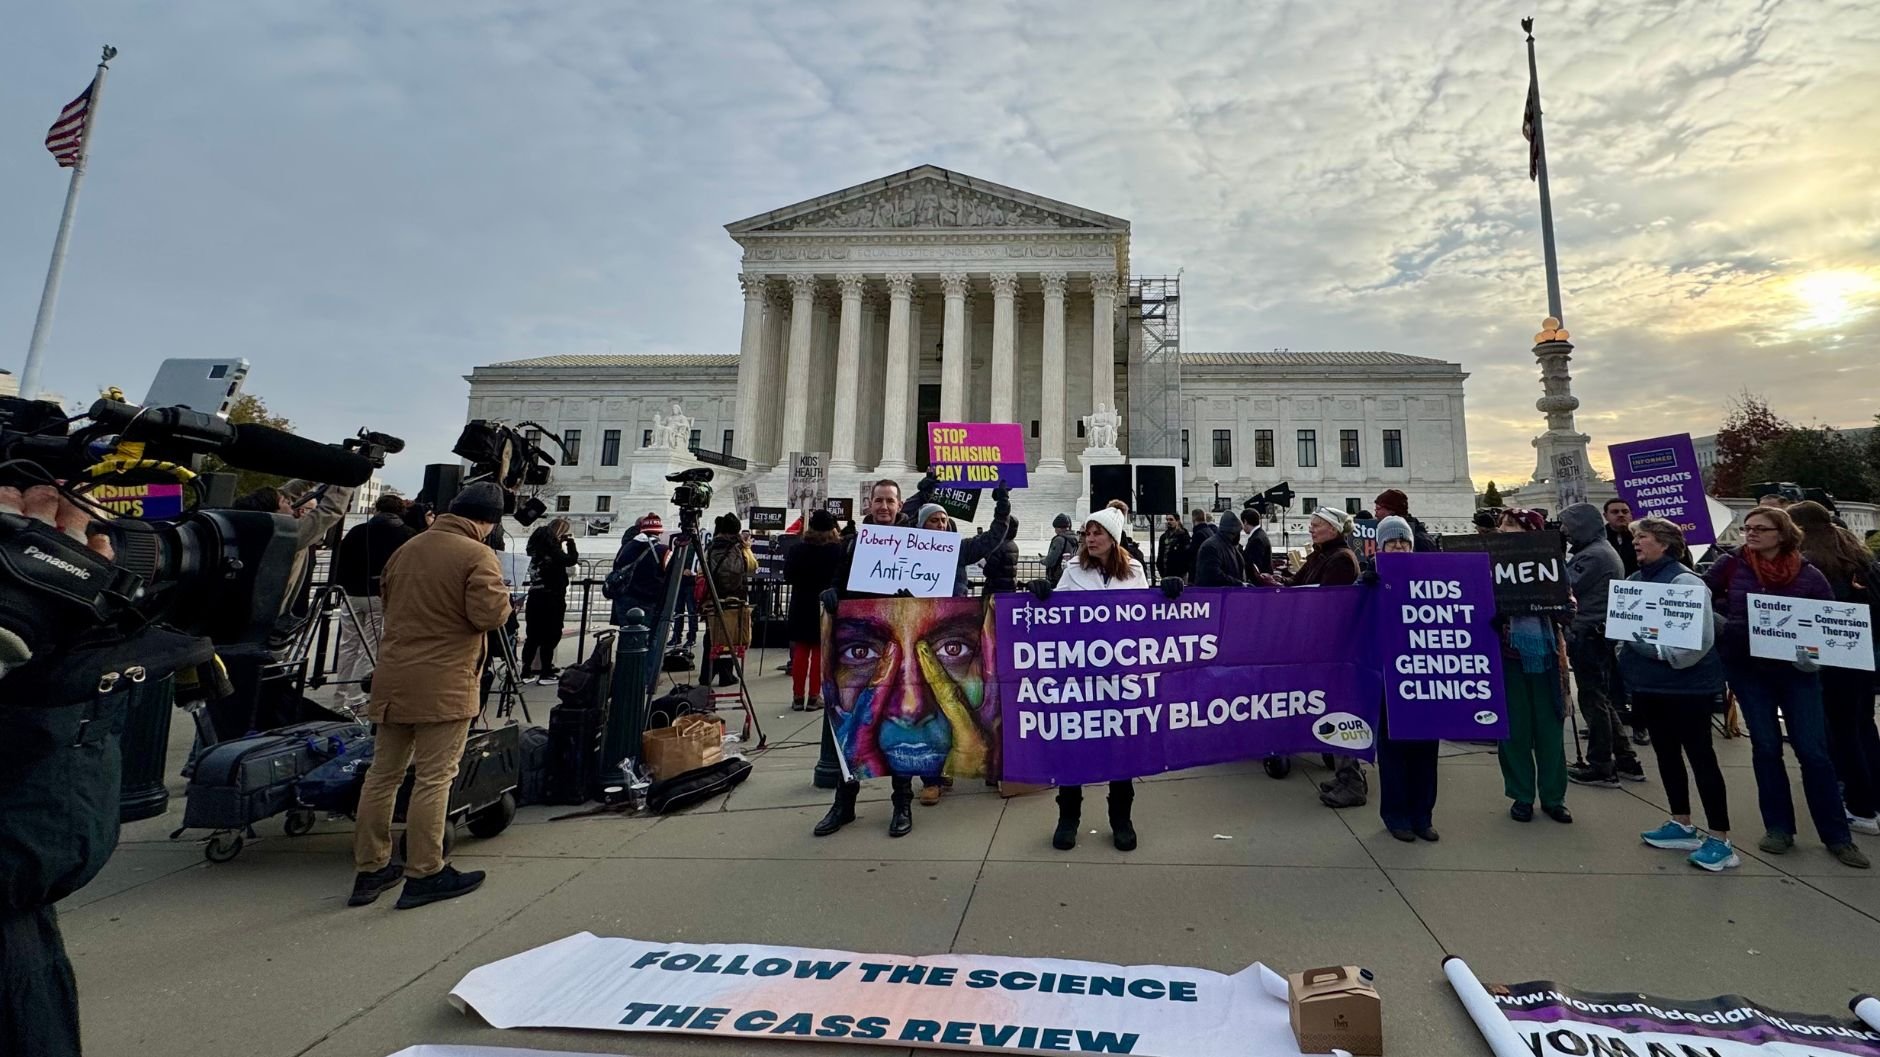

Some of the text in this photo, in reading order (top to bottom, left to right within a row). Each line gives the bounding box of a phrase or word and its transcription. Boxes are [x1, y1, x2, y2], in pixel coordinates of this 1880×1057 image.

[933, 428, 967, 444] STOP
[934, 446, 1001, 462] TRANSING
[795, 467, 823, 478] HEALTH
[936, 465, 999, 482] GAY KIDS
[1623, 472, 1692, 488] DEMOCRATS
[952, 488, 973, 503] HELP
[1636, 484, 1684, 497] AGAINST
[1638, 496, 1688, 508] MEDICAL
[769, 513, 782, 521] HELP
[1647, 507, 1685, 519] ABUSE
[1352, 523, 1376, 538] Sto
[860, 529, 954, 555] Puberty Blockers
[24, 545, 92, 580] Panasonic
[870, 560, 940, 592] Anti-Gay
[1490, 558, 1559, 584] MEN
[1409, 581, 1462, 599] KIDS
[1613, 585, 1643, 596] Gender
[1658, 597, 1702, 609] Conversion
[1754, 599, 1792, 612] Gender
[1080, 605, 1110, 623] DO
[1116, 603, 1147, 622] NO
[1152, 602, 1210, 620] HARM
[1401, 604, 1474, 623] DON'T
[1609, 609, 1643, 621] Medicine
[1663, 608, 1694, 620] Therapy
[1815, 614, 1868, 628] Conversion
[1409, 630, 1472, 649] NEED
[1752, 626, 1797, 639] Medicine
[1821, 626, 1860, 639] Therapy
[1013, 634, 1218, 669] DEMOCRATS
[1395, 655, 1491, 674] GENDER
[1017, 672, 1161, 704] AGAINST
[1399, 680, 1492, 700] CLINICS
[1019, 690, 1326, 741] PUBERTY BLOCKERS
[1338, 720, 1363, 731] OUR
[1341, 730, 1370, 741] DUTY
[630, 951, 1198, 1001] FOLLOW THE SCIENCE
[618, 1002, 1140, 1054] THE CASS REVIEW
